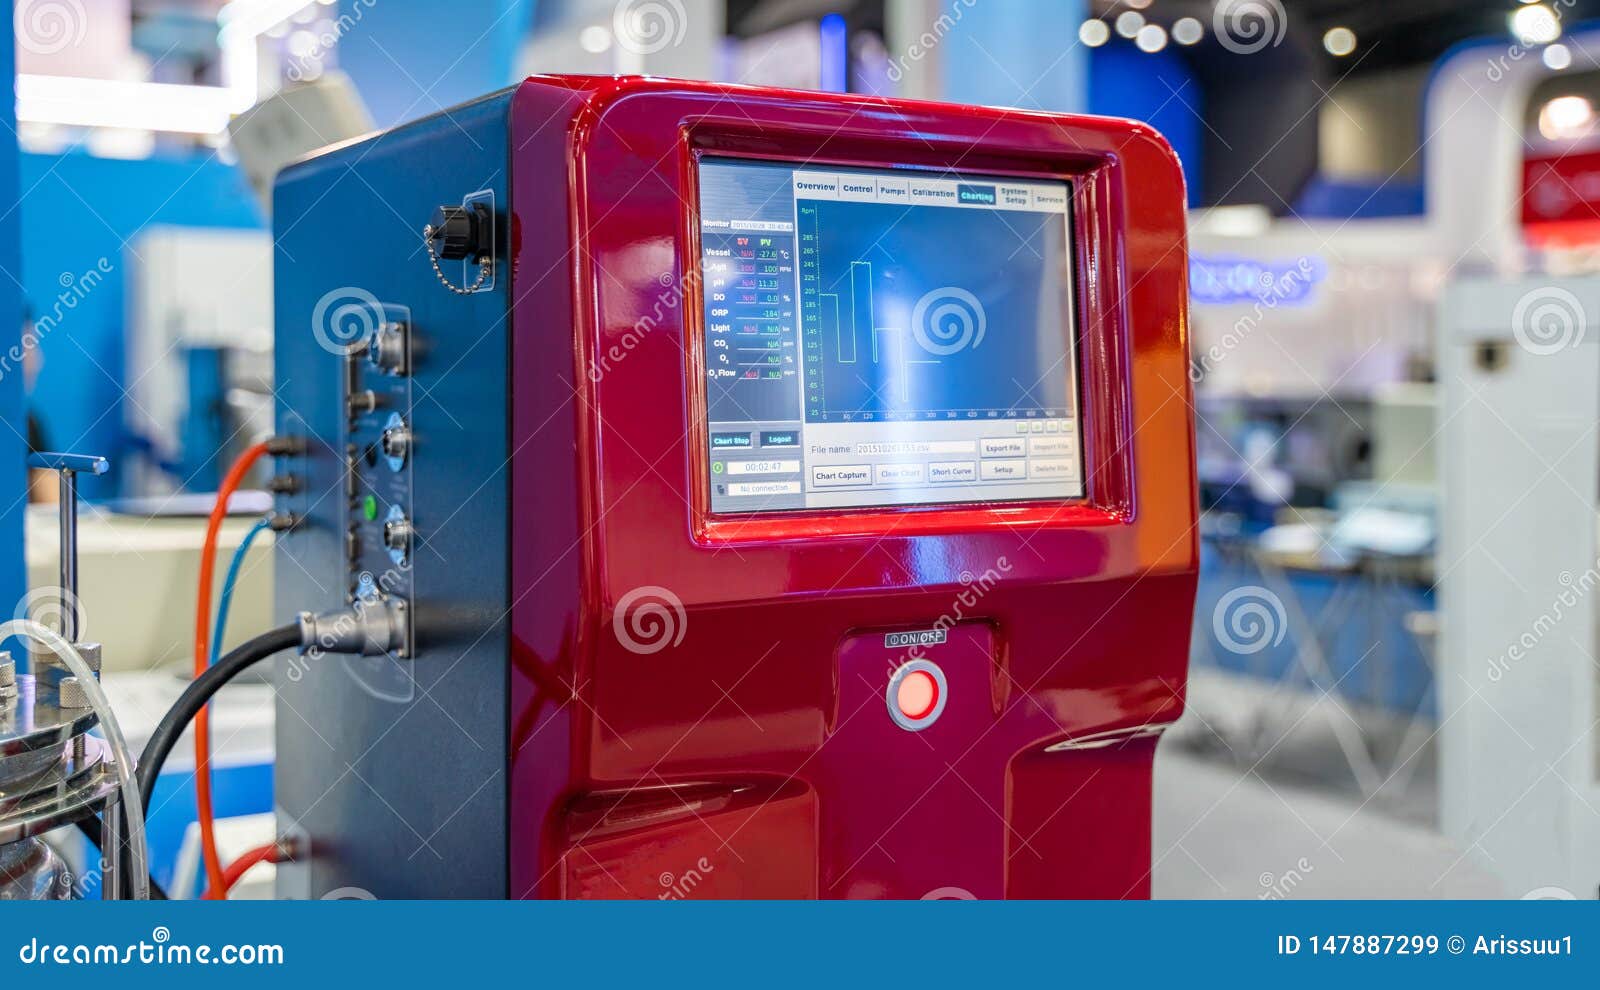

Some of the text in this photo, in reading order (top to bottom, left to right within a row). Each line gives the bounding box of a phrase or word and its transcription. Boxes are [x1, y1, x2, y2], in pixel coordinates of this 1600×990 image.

[797, 182, 836, 191] Overview
[843, 185, 873, 193] Control
[880, 187, 906, 195] Pumps
[912, 189, 955, 198] Calibration
[1001, 188, 1028, 196] System
[961, 192, 994, 202] Charting
[1005, 197, 1026, 205] Setup
[703, 219, 730, 229] Monitor
[760, 238, 772, 247] PV
[705, 247, 731, 257] Vessel
[741, 250, 753, 258] N/A
[764, 265, 777, 273] 100
[713, 279, 724, 288] pH
[713, 292, 726, 302] DO
[767, 294, 778, 302] 0.0
[711, 308, 729, 317] ORP
[711, 324, 731, 334] Light
[767, 325, 780, 333] N/A
[767, 340, 780, 348] N/A
[767, 355, 780, 363] N/A
[718, 369, 737, 377] Flow
[714, 437, 749, 445] Chart Stop
[769, 435, 792, 443] Logout
[811, 445, 826, 454] File
[828, 446, 851, 454] name
[986, 444, 1021, 453] Export File
[932, 467, 972, 476] Short Curve
[994, 466, 1013, 474] Setup
[838, 471, 867, 480] Capture
[741, 484, 788, 493] No connection
[901, 630, 944, 644] ON/OFF
